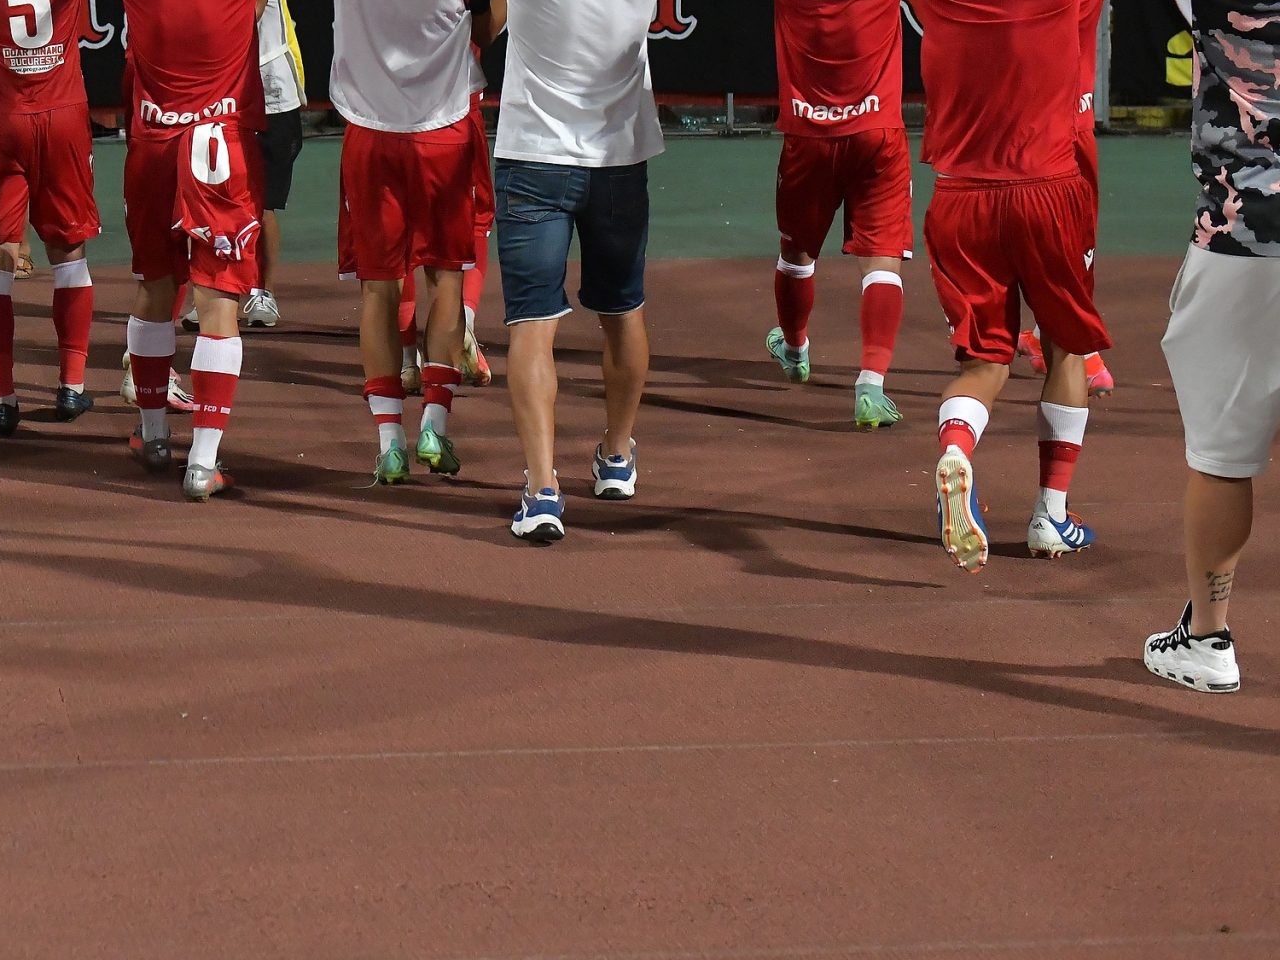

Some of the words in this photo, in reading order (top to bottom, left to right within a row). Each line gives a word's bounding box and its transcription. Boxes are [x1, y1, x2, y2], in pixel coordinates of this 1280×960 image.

[4, 48, 28, 57] DOAR
[31, 45, 63, 56] DINAMO
[140, 97, 237, 125] macron
[792, 94, 880, 121] macron
[203, 404, 217, 412] FCD
